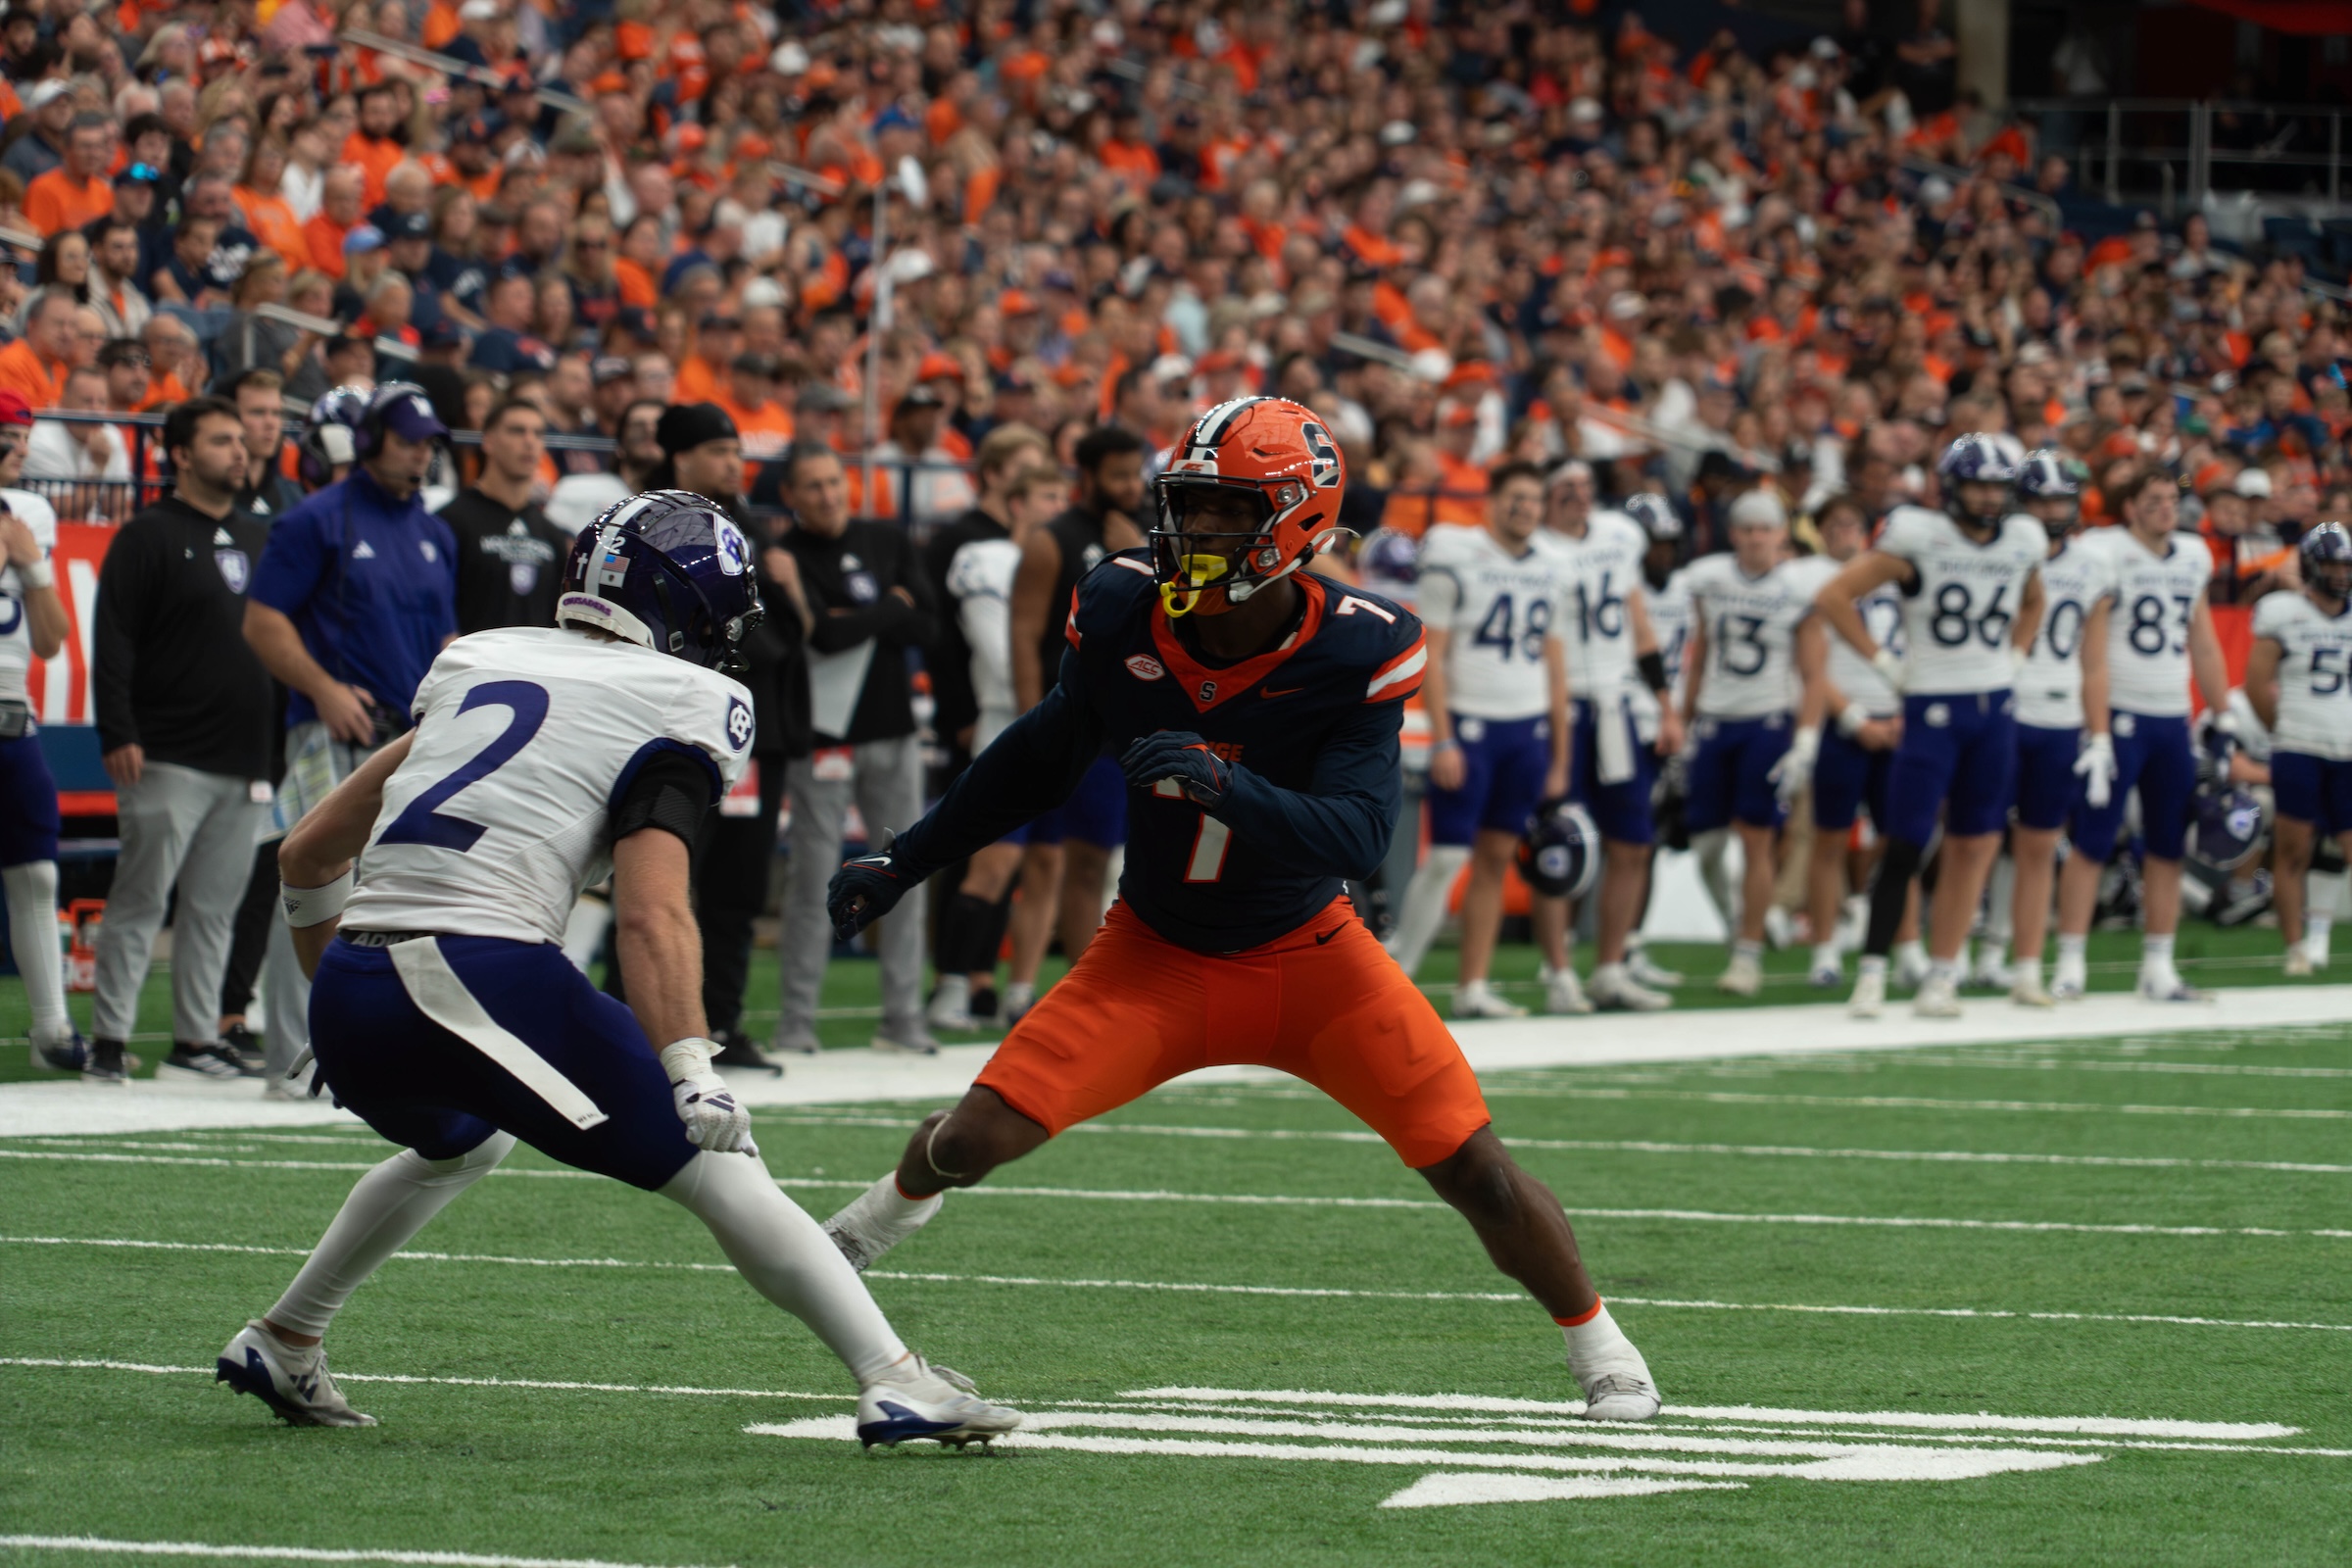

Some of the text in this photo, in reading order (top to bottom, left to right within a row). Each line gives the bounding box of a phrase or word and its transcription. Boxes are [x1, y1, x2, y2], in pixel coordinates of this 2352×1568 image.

[1300, 421, 1341, 488] S
[609, 536, 626, 555] 2
[563, 596, 612, 616] CRUSADERS
[1335, 595, 1396, 625] 7
[1472, 592, 1549, 662] 48
[1577, 570, 1623, 644] 16
[1932, 582, 2011, 648] 86
[1133, 660, 1158, 675] ACC
[1717, 612, 1769, 675] 13
[2310, 648, 2352, 693] 5
[1199, 680, 1217, 703] S
[374, 680, 550, 853] 2
